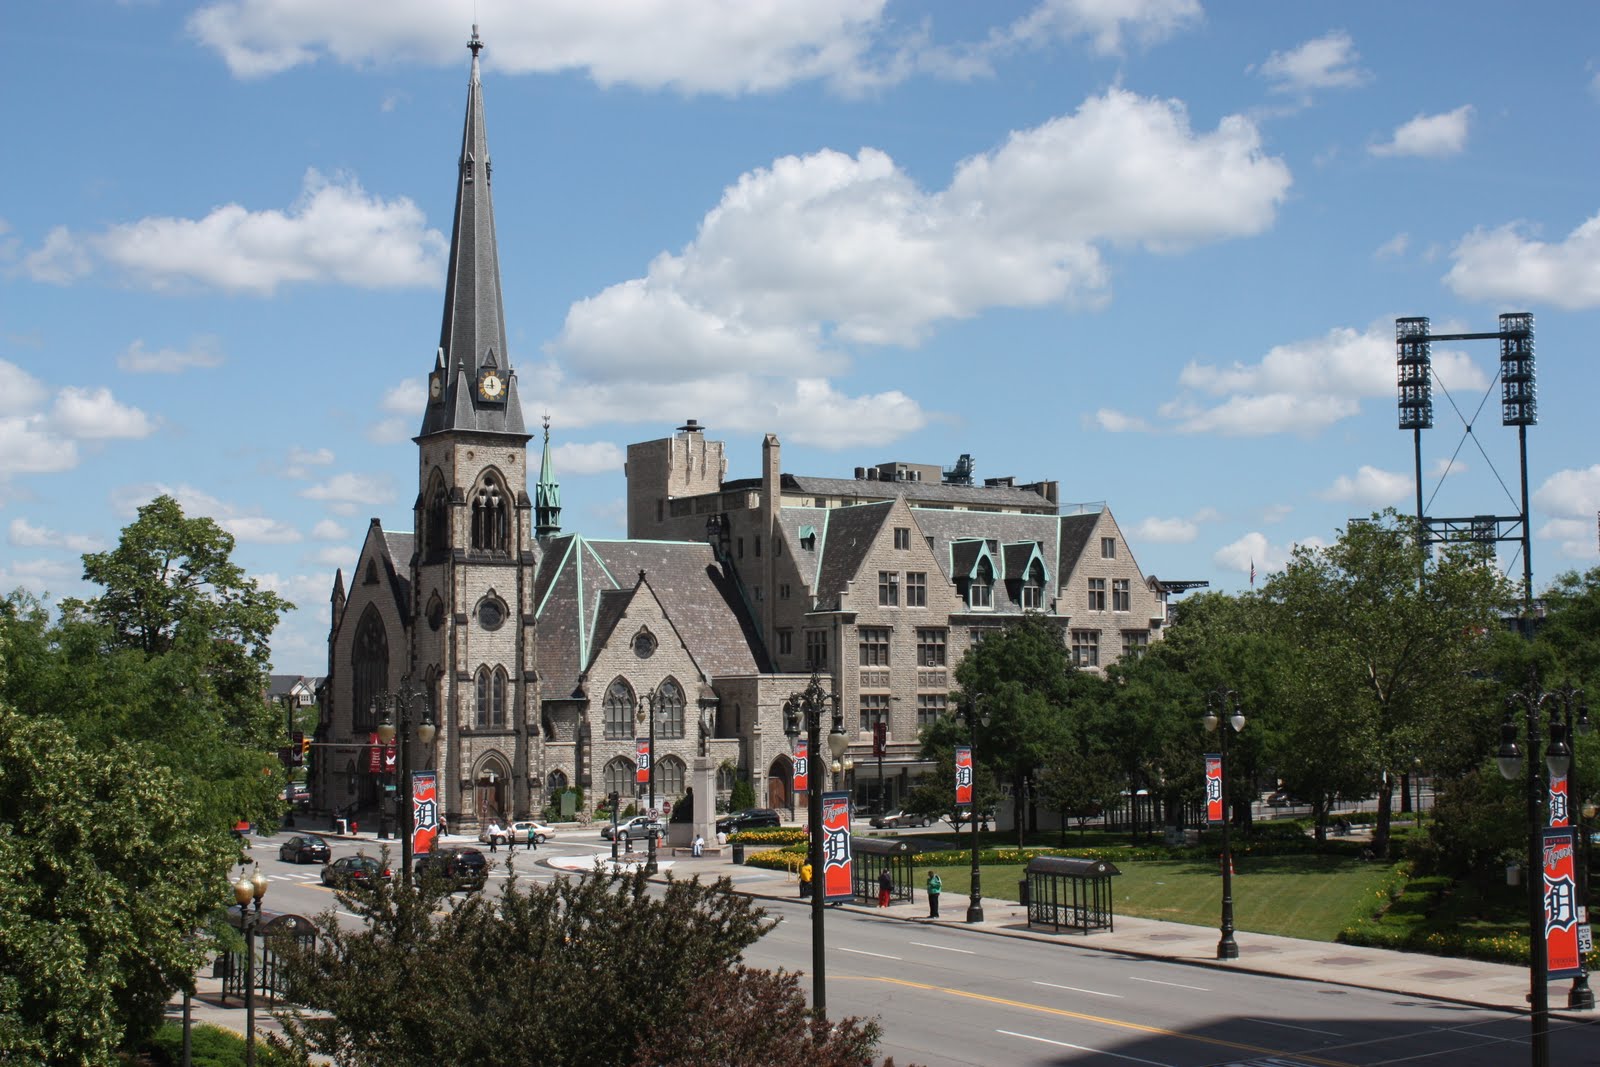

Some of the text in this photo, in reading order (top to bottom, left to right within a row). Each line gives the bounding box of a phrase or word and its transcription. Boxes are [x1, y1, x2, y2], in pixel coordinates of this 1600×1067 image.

[636, 753, 650, 773] D
[793, 756, 808, 779] D
[956, 764, 972, 790] D
[1206, 775, 1222, 806] D
[413, 798, 437, 835] D
[823, 804, 849, 823] Tigers
[1549, 789, 1568, 826] D
[822, 825, 852, 873] D
[1543, 844, 1573, 870] Tigers
[1543, 874, 1577, 939] D
[1579, 939, 1591, 950] 25
